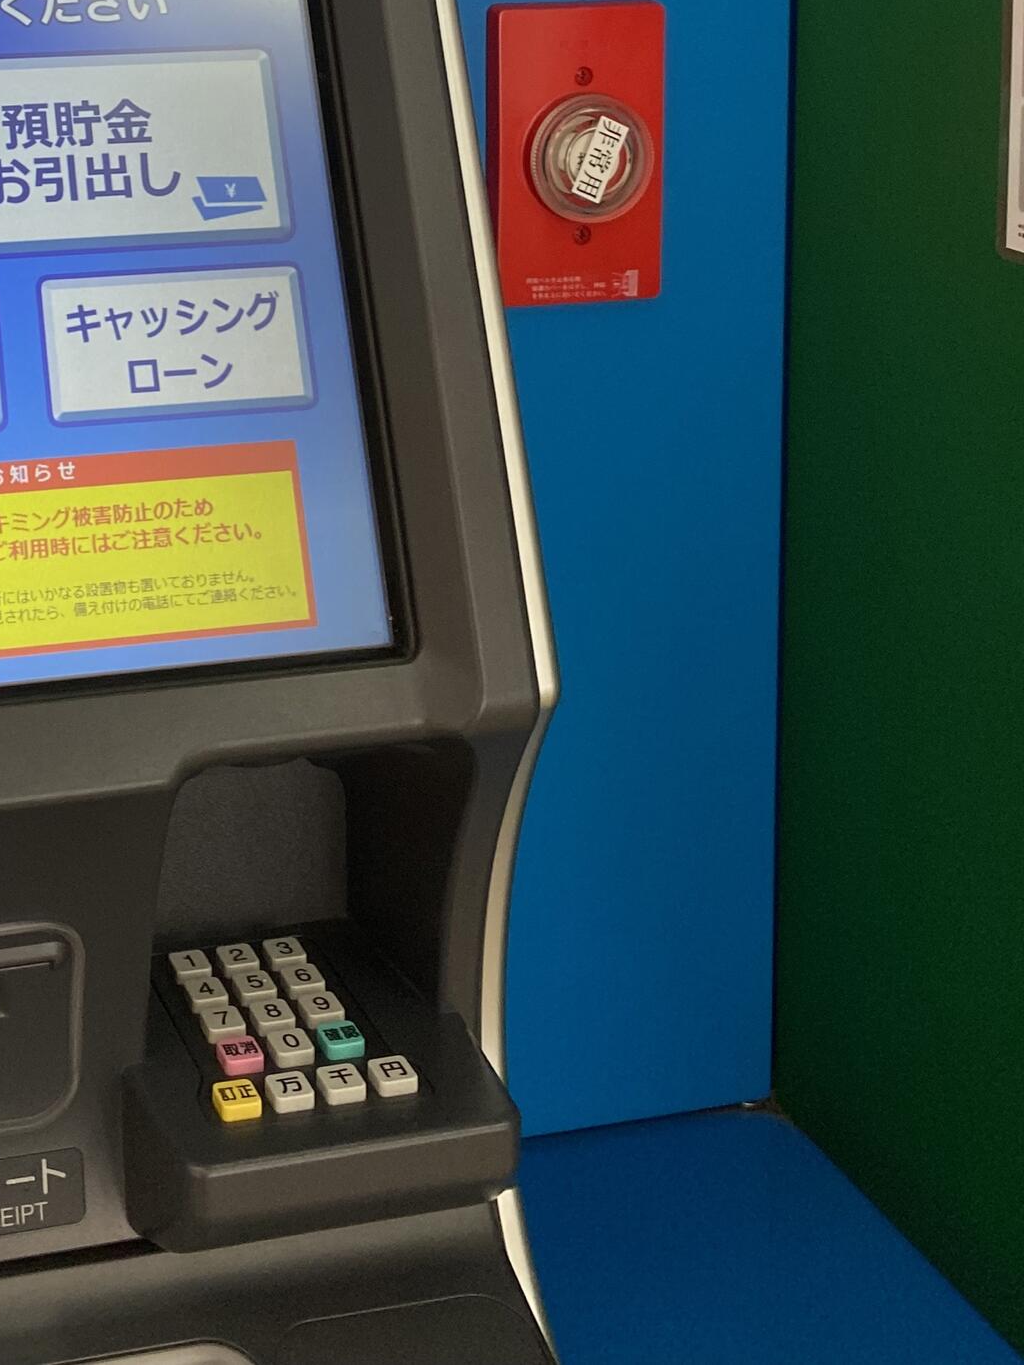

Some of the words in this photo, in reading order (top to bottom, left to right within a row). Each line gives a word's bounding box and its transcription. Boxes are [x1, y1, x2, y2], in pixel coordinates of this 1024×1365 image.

[1, 99, 153, 150] 預貯金
[577, 121, 622, 200] 非常用
[65, 292, 279, 343] キャッシング
[127, 353, 233, 394] ローン
[229, 948, 247, 961] 2
[276, 941, 293, 954] 3
[184, 955, 196, 967] 1
[246, 975, 263, 988] 5
[295, 969, 311, 982] 6
[199, 982, 215, 995] 4
[313, 996, 330, 1010] 9
[264, 1004, 282, 1018] 8
[213, 1012, 228, 1025] 7
[223, 1040, 259, 1056] 取消
[282, 1034, 300, 1048] 0
[380, 1060, 407, 1077] 円
[328, 1068, 353, 1084] 千
[276, 1076, 302, 1093] 万
[219, 1084, 257, 1101] 訂正
